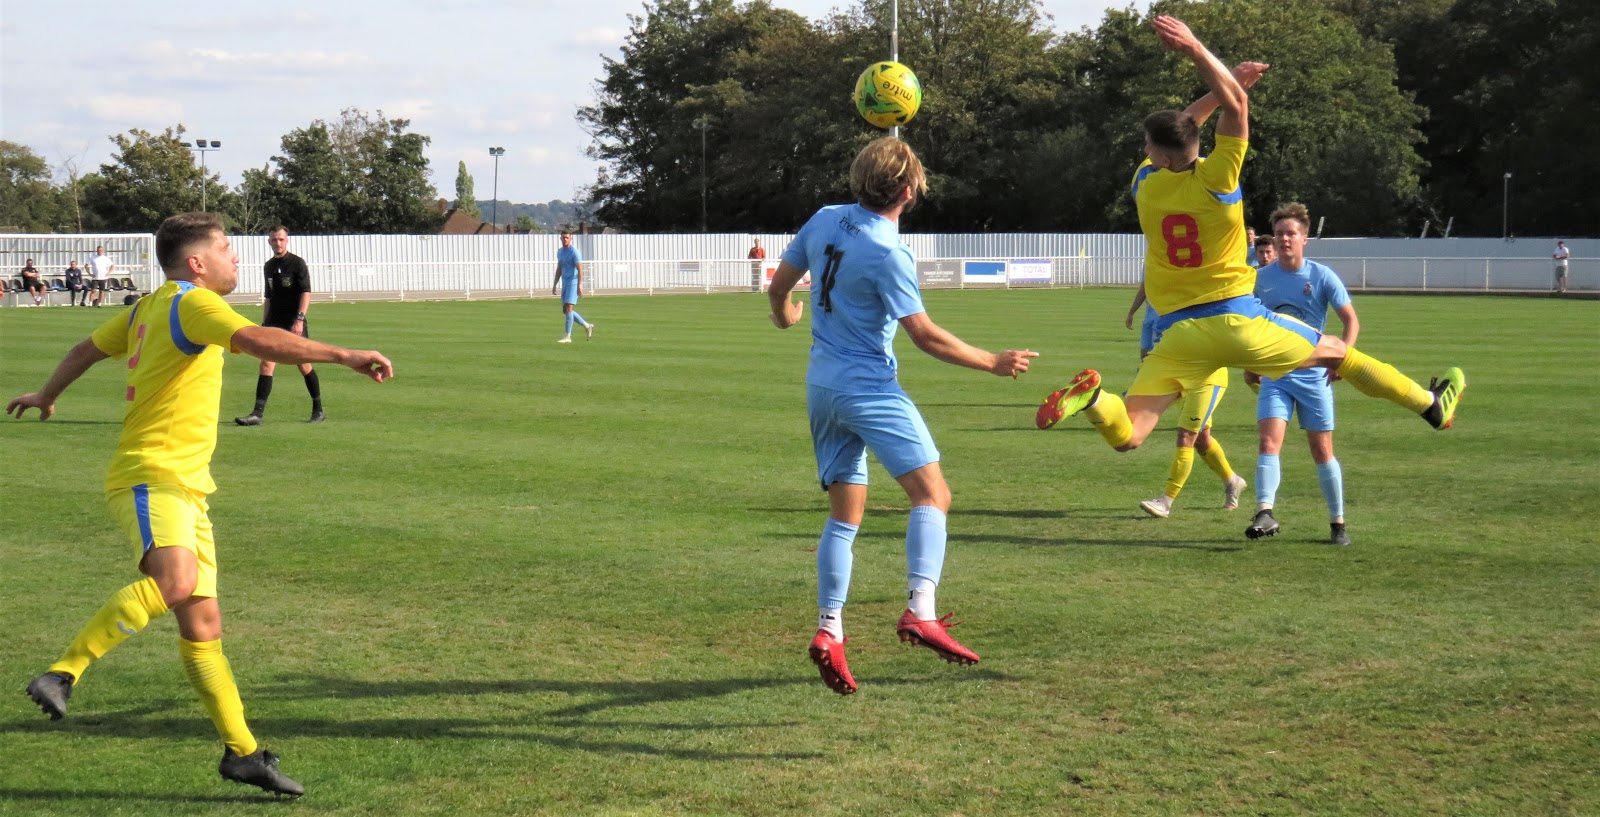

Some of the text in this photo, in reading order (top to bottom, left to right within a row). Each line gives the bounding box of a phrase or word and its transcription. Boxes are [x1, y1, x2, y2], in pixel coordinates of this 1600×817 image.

[883, 81, 912, 101] mitre
[1161, 214, 1203, 267] 8
[1022, 265, 1047, 274] TOTAL
